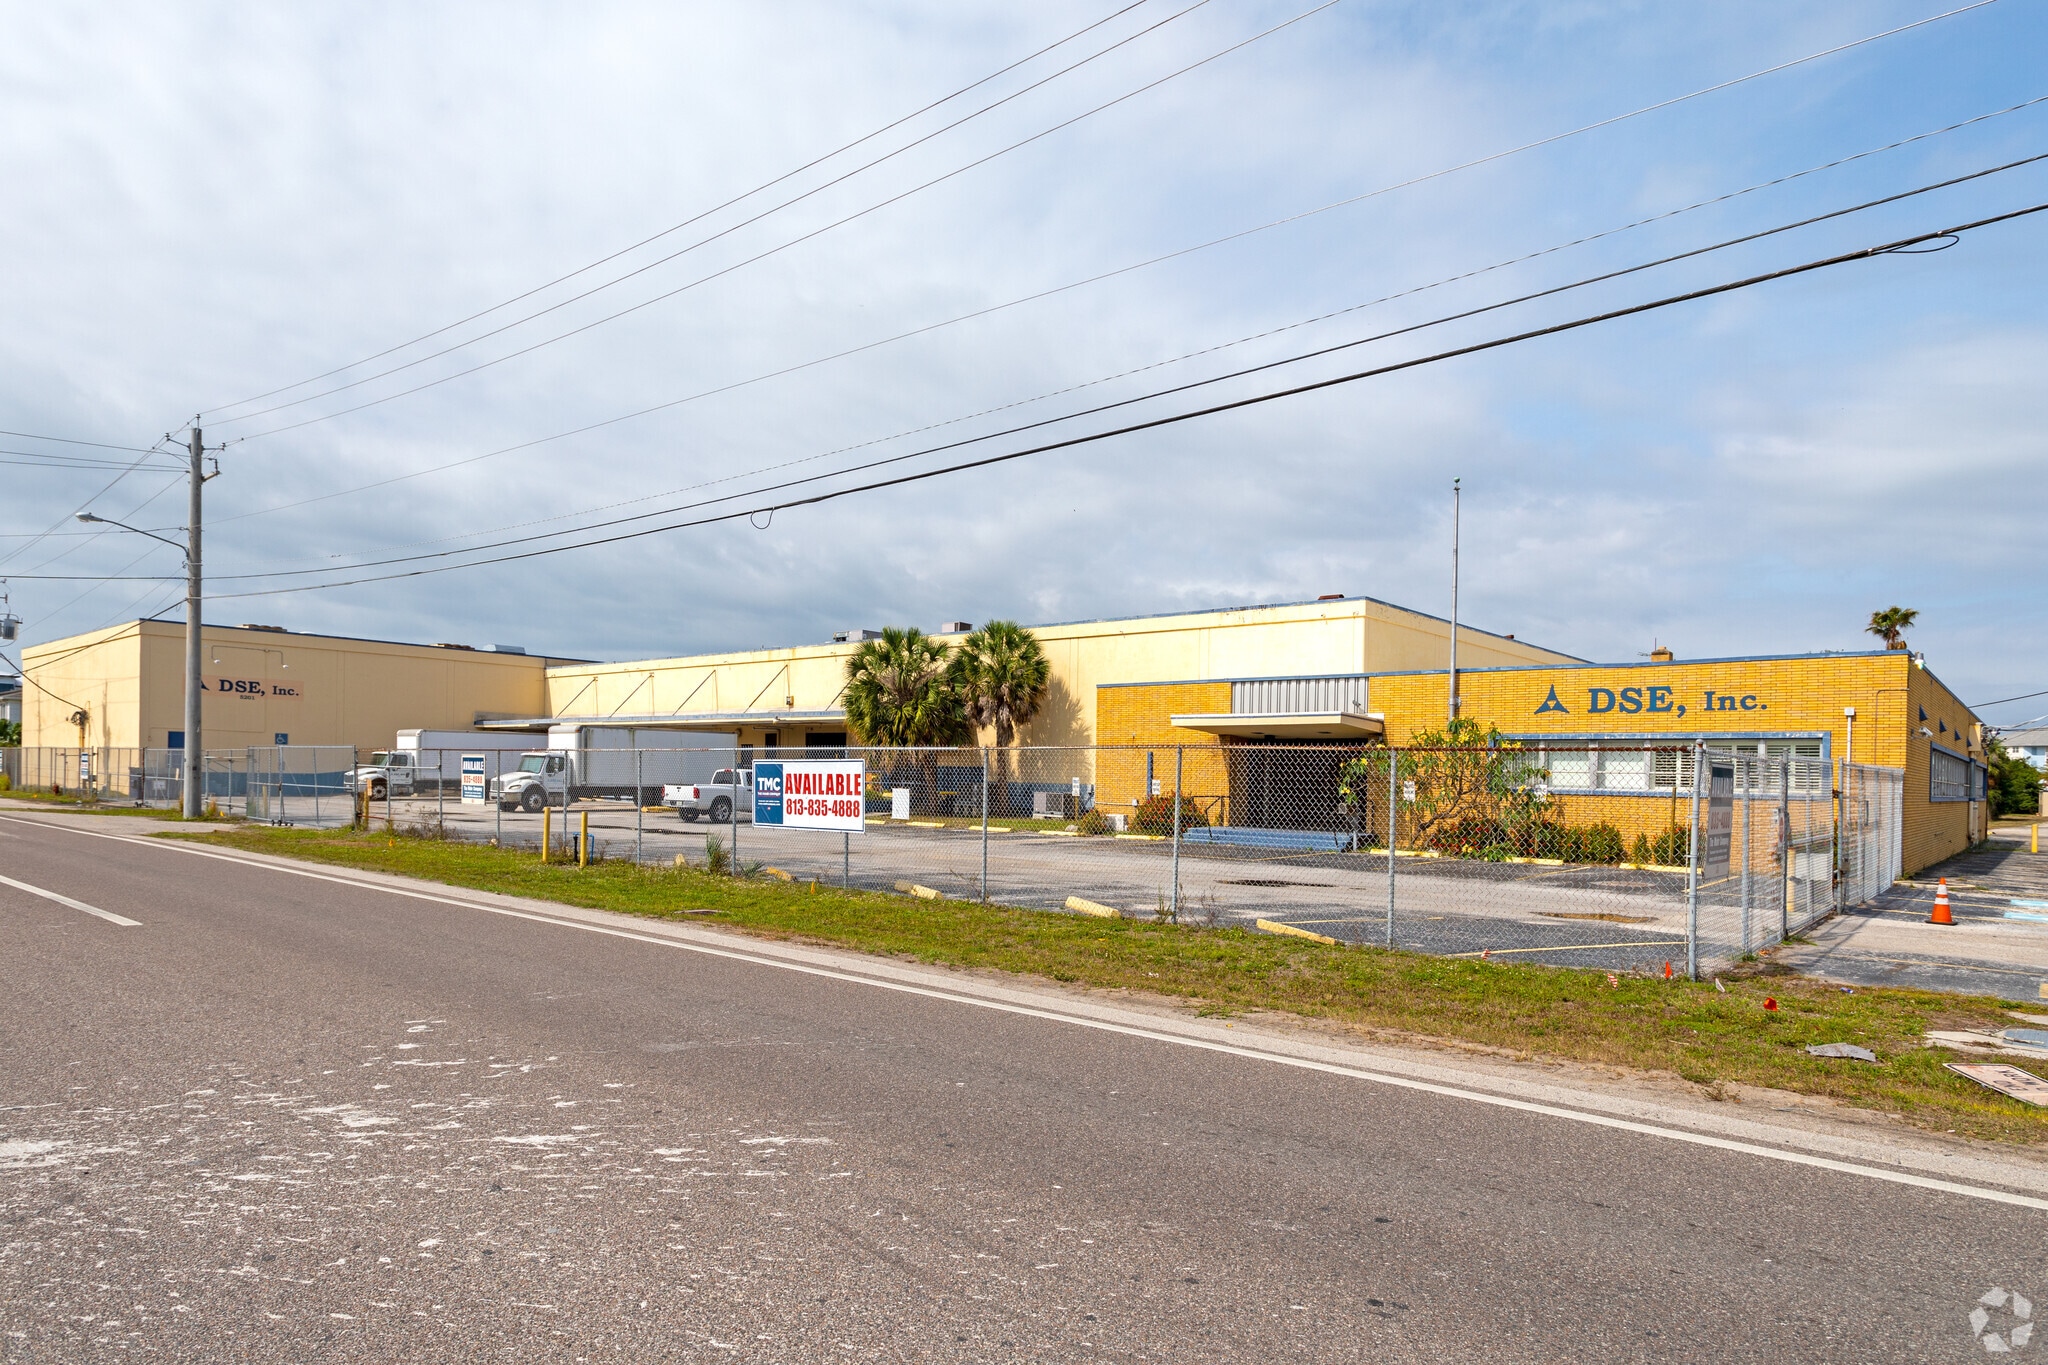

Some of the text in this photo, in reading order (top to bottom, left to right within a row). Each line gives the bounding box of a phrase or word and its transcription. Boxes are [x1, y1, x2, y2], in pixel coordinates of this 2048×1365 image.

[219, 679, 299, 696] DSE, Inc.
[1587, 686, 1768, 718] DSE, Inc.
[757, 777, 781, 791] TMC
[785, 773, 861, 795] AVAILABLE
[786, 798, 860, 817] 813-835-4888
